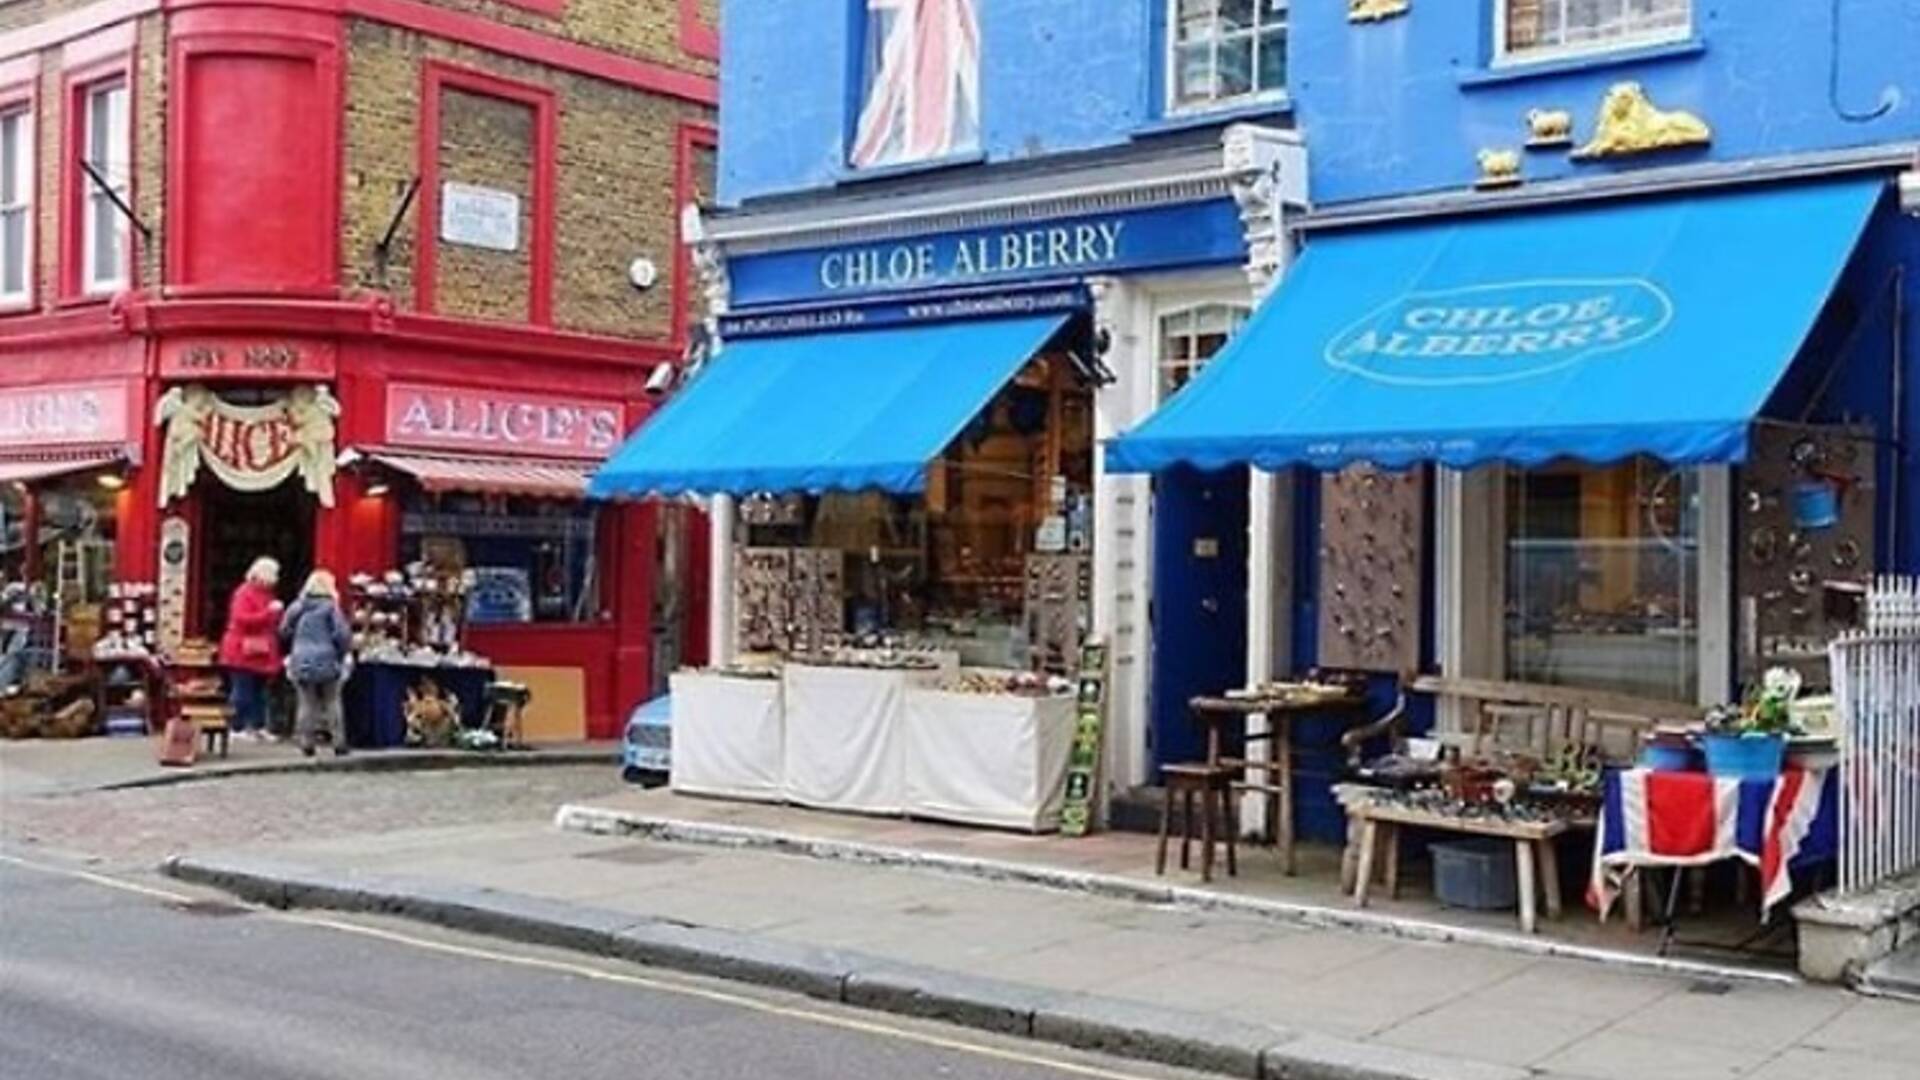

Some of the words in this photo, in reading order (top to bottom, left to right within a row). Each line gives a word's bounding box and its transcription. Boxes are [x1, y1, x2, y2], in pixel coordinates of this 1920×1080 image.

[820, 244, 938, 291] CHLOE
[952, 222, 1125, 277] ALBERRY
[1338, 313, 1646, 358] ALBERRY
[1402, 295, 1615, 331] CHLOE
[395, 394, 618, 449] ALICE'S
